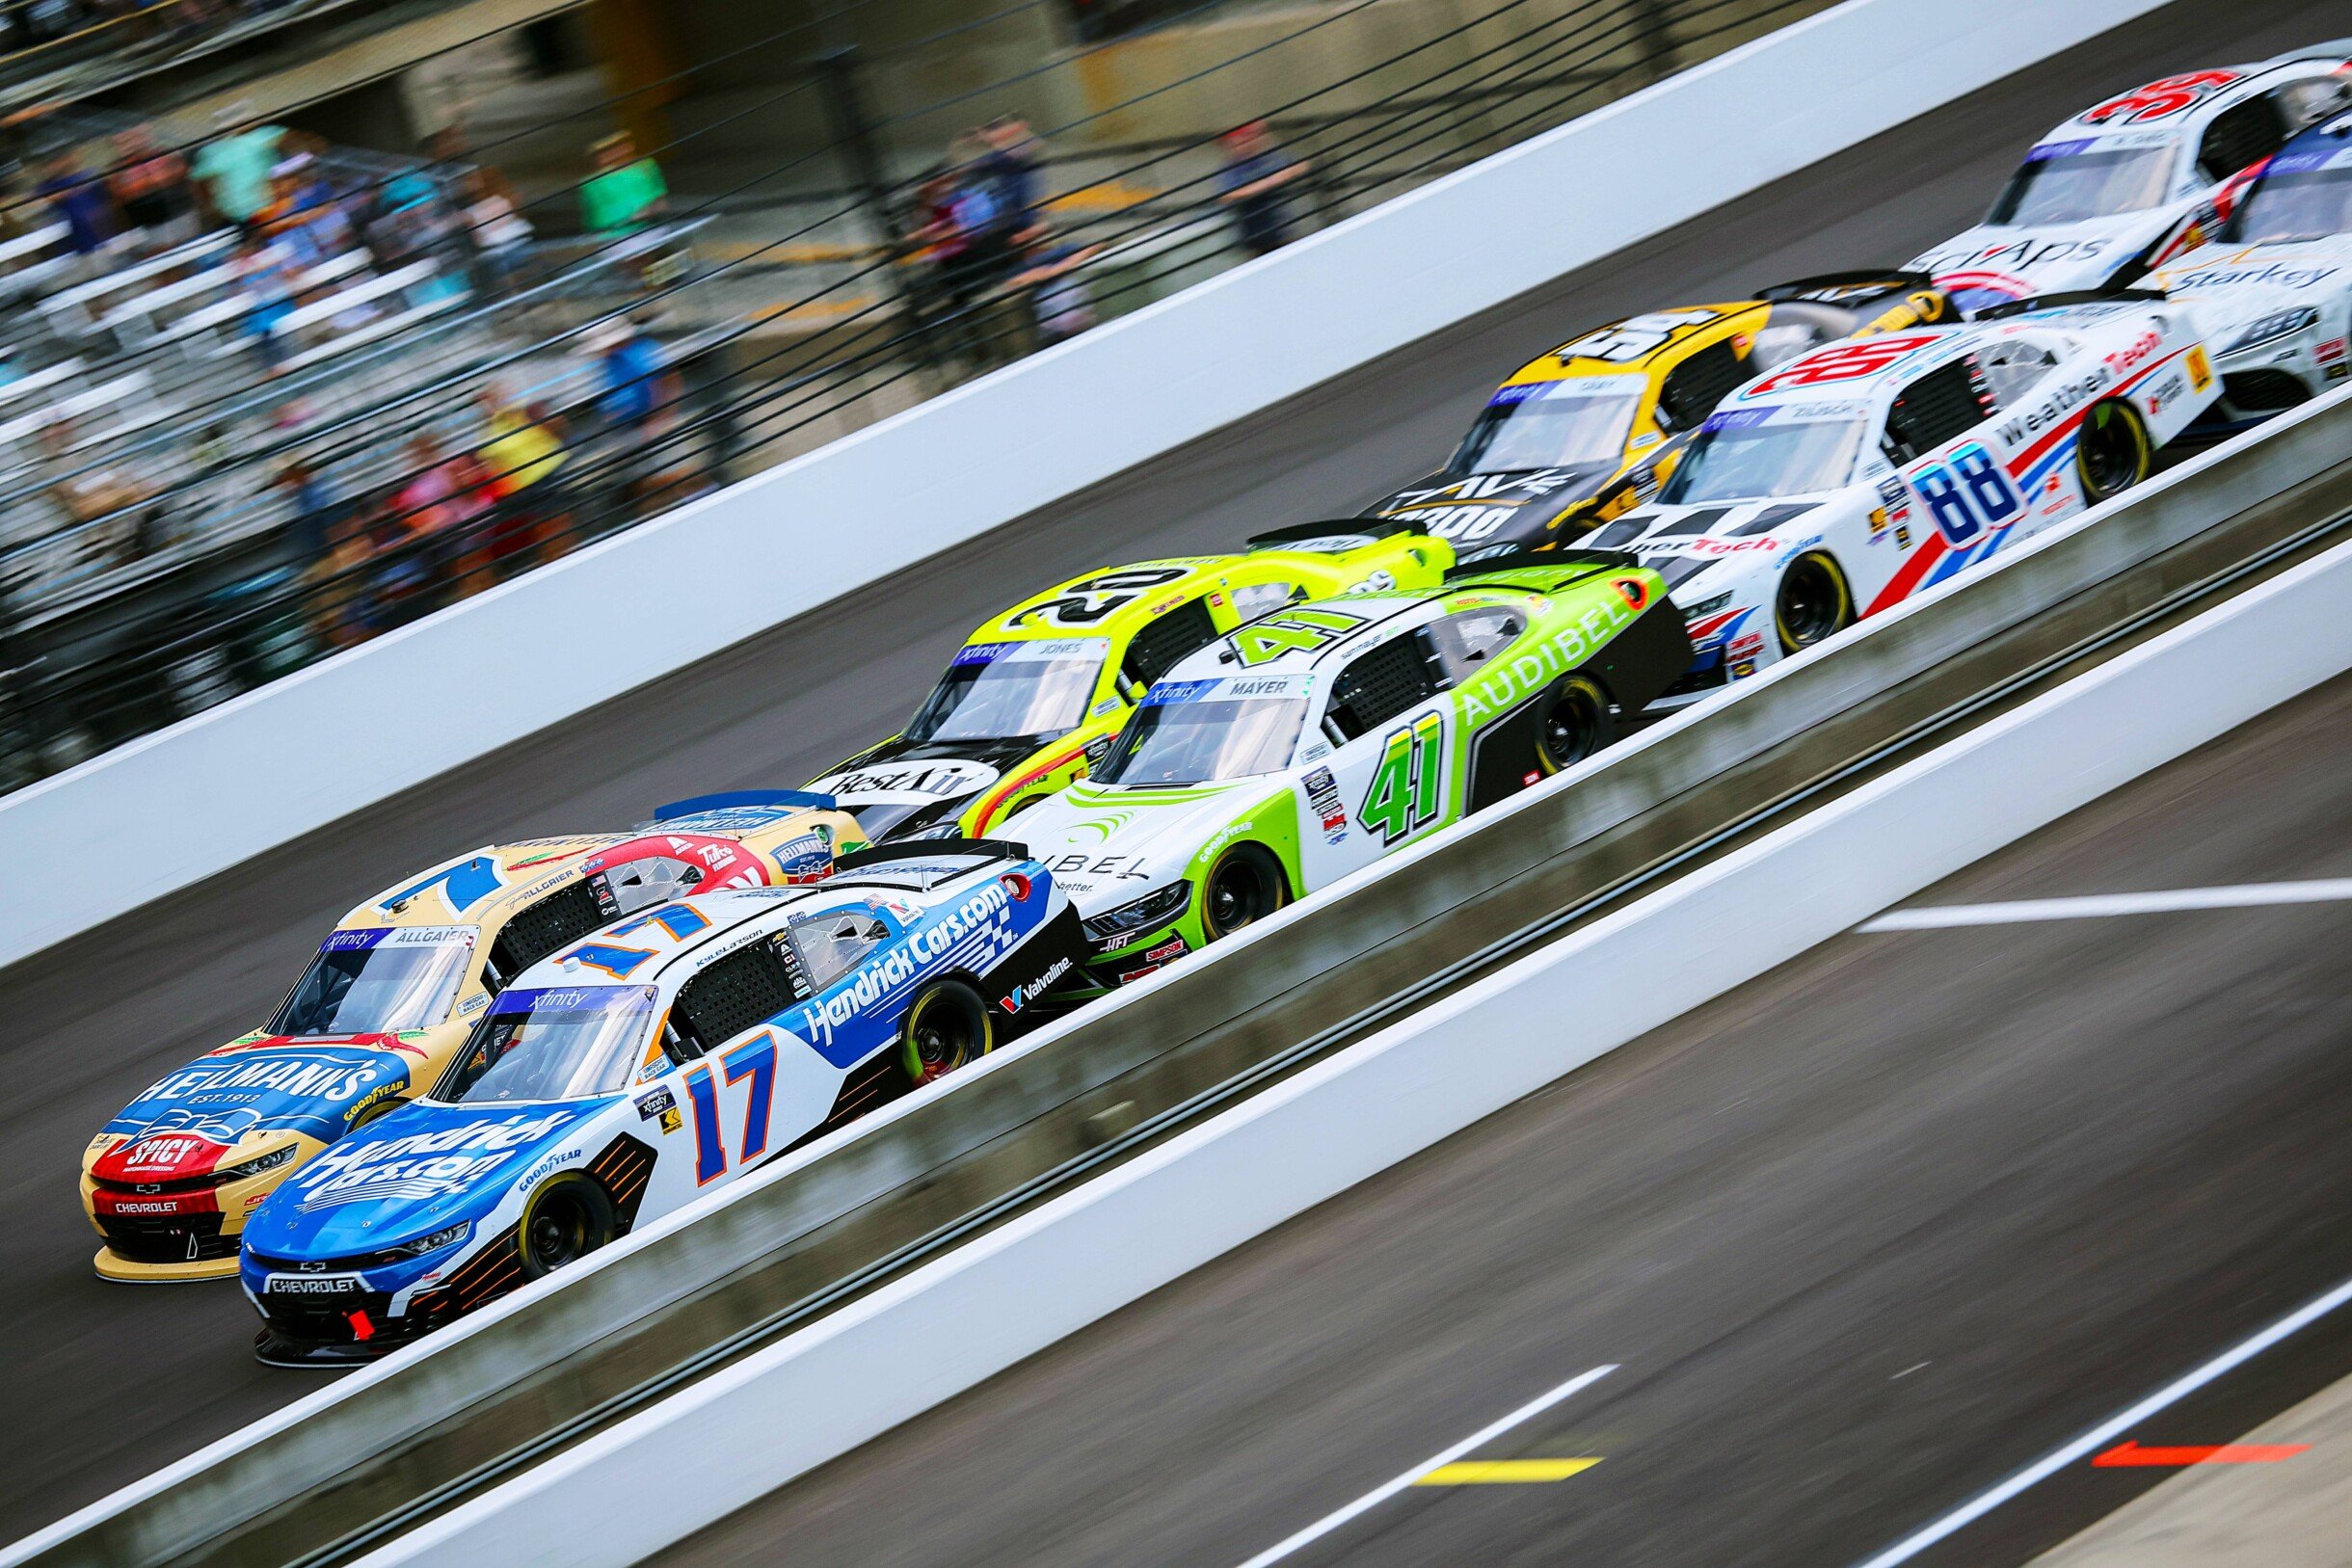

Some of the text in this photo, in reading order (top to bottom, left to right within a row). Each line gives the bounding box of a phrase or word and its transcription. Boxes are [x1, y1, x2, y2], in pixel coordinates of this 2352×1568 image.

[1747, 333, 1946, 396] 88
[1908, 439, 2024, 548] 88
[1038, 641, 1082, 655] JONES
[1228, 607, 1372, 670] 41
[1462, 600, 1629, 726] AUDIBEL
[1152, 684, 1201, 703] xfinity
[1229, 680, 1289, 696] MAYER
[1357, 708, 1445, 847] 41
[523, 869, 575, 899] ALLGAIER
[327, 931, 374, 950] xfinity
[395, 930, 469, 943] ALLGAIER
[552, 903, 713, 981] 17
[529, 989, 589, 1010] xfinity
[131, 1060, 378, 1106] HELLMANN'S
[343, 1080, 405, 1122] GOODYEAR
[682, 1029, 778, 1188] 17
[126, 1139, 200, 1165] SPICY
[519, 1148, 582, 1192] GOODYEAR
[116, 1202, 177, 1213] CHEVROLET
[271, 1278, 357, 1293] CHEVROLET
